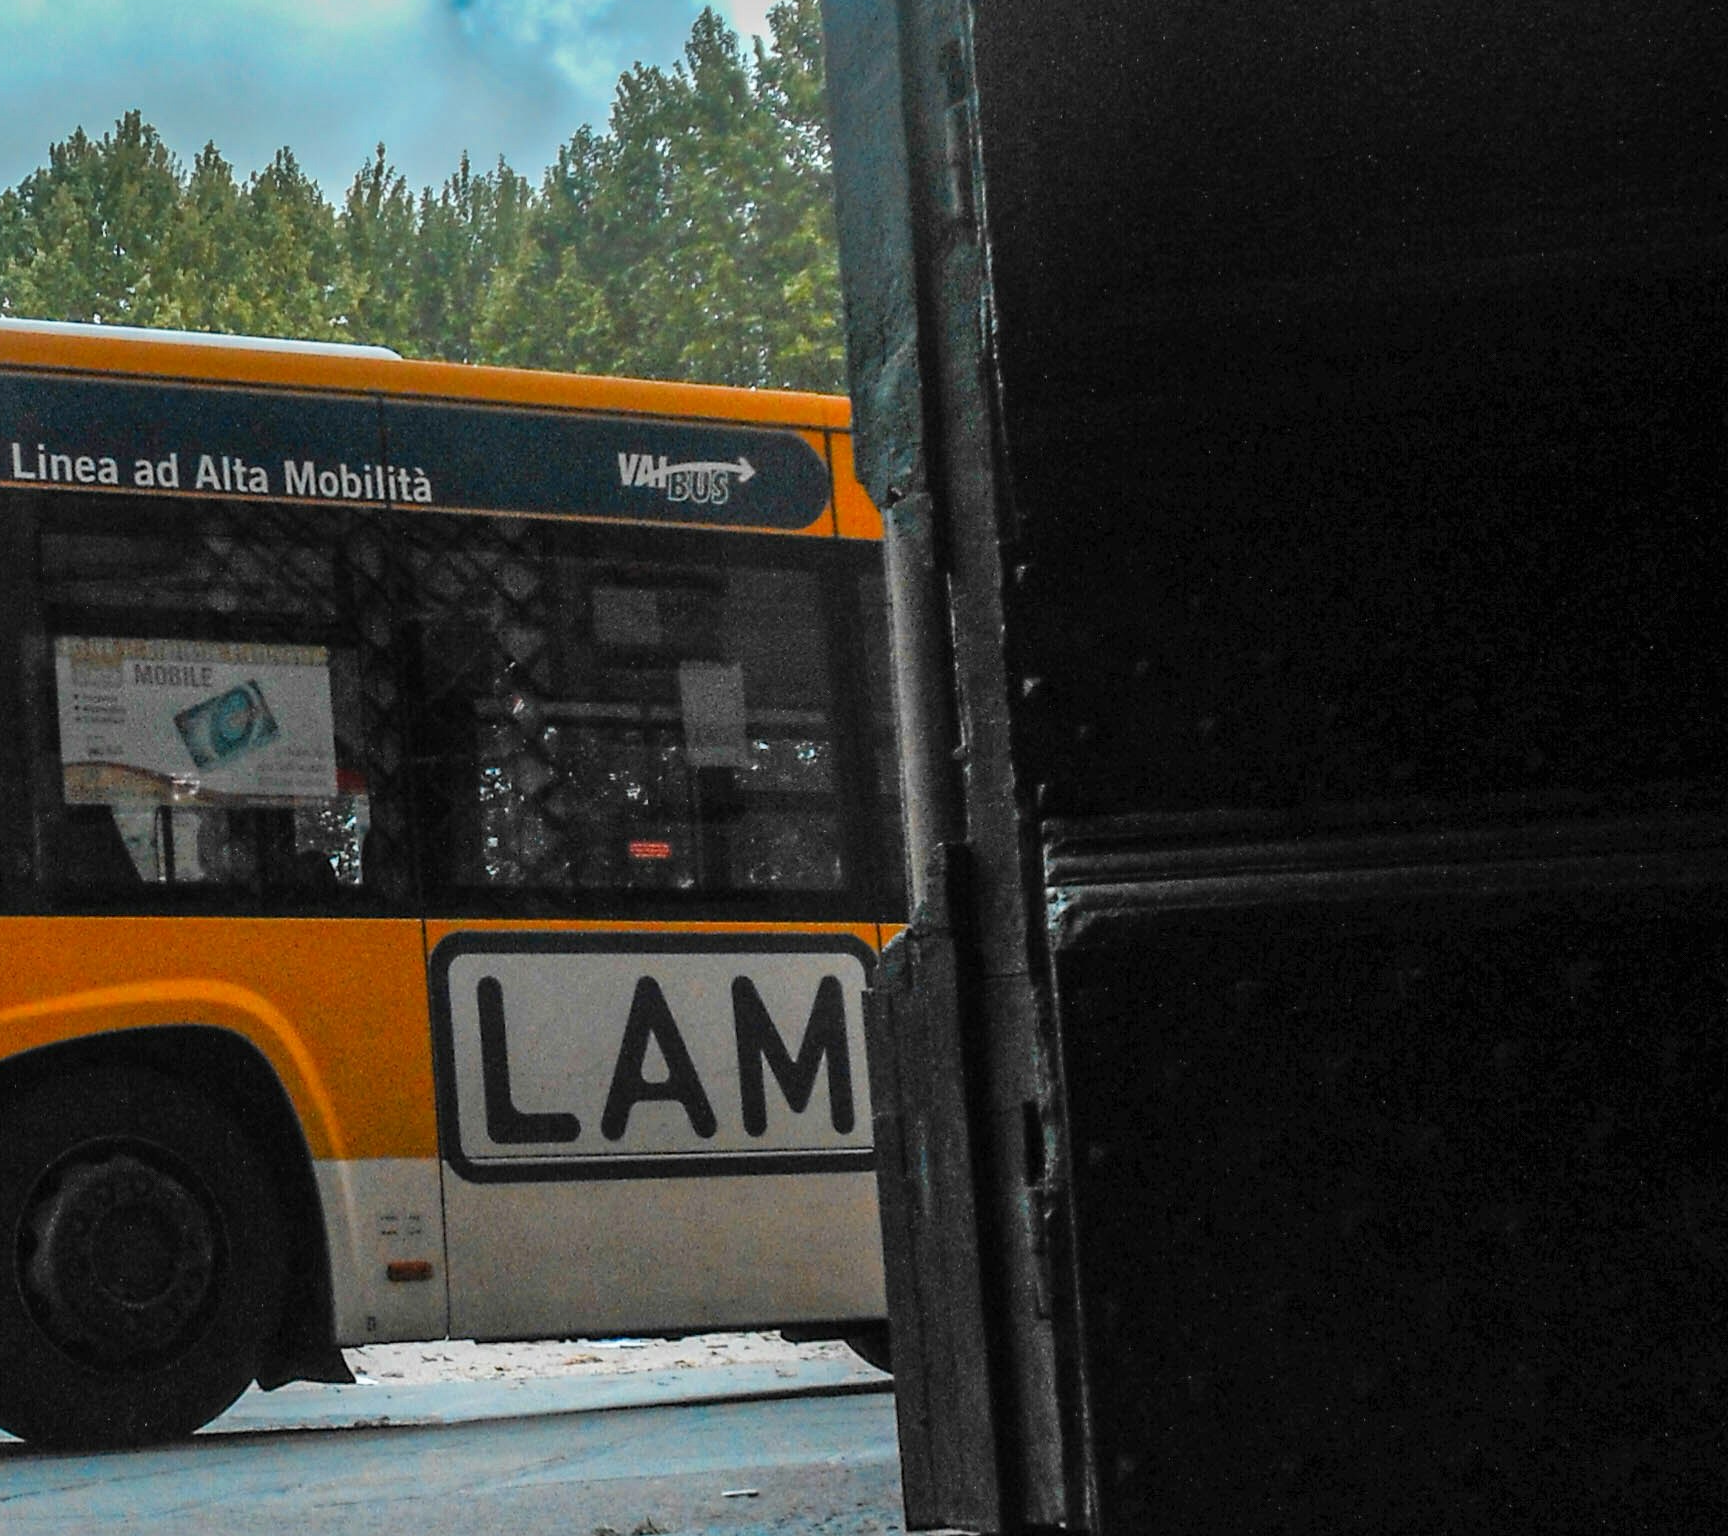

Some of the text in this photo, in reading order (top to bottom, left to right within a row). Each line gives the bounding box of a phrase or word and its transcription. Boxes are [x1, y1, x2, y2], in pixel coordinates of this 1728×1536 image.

[12, 442, 432, 502] Linea ad Alta Mobilità
[668, 470, 729, 505] BUS
[134, 664, 213, 688] MOBILE
[476, 976, 855, 1144] LAM
